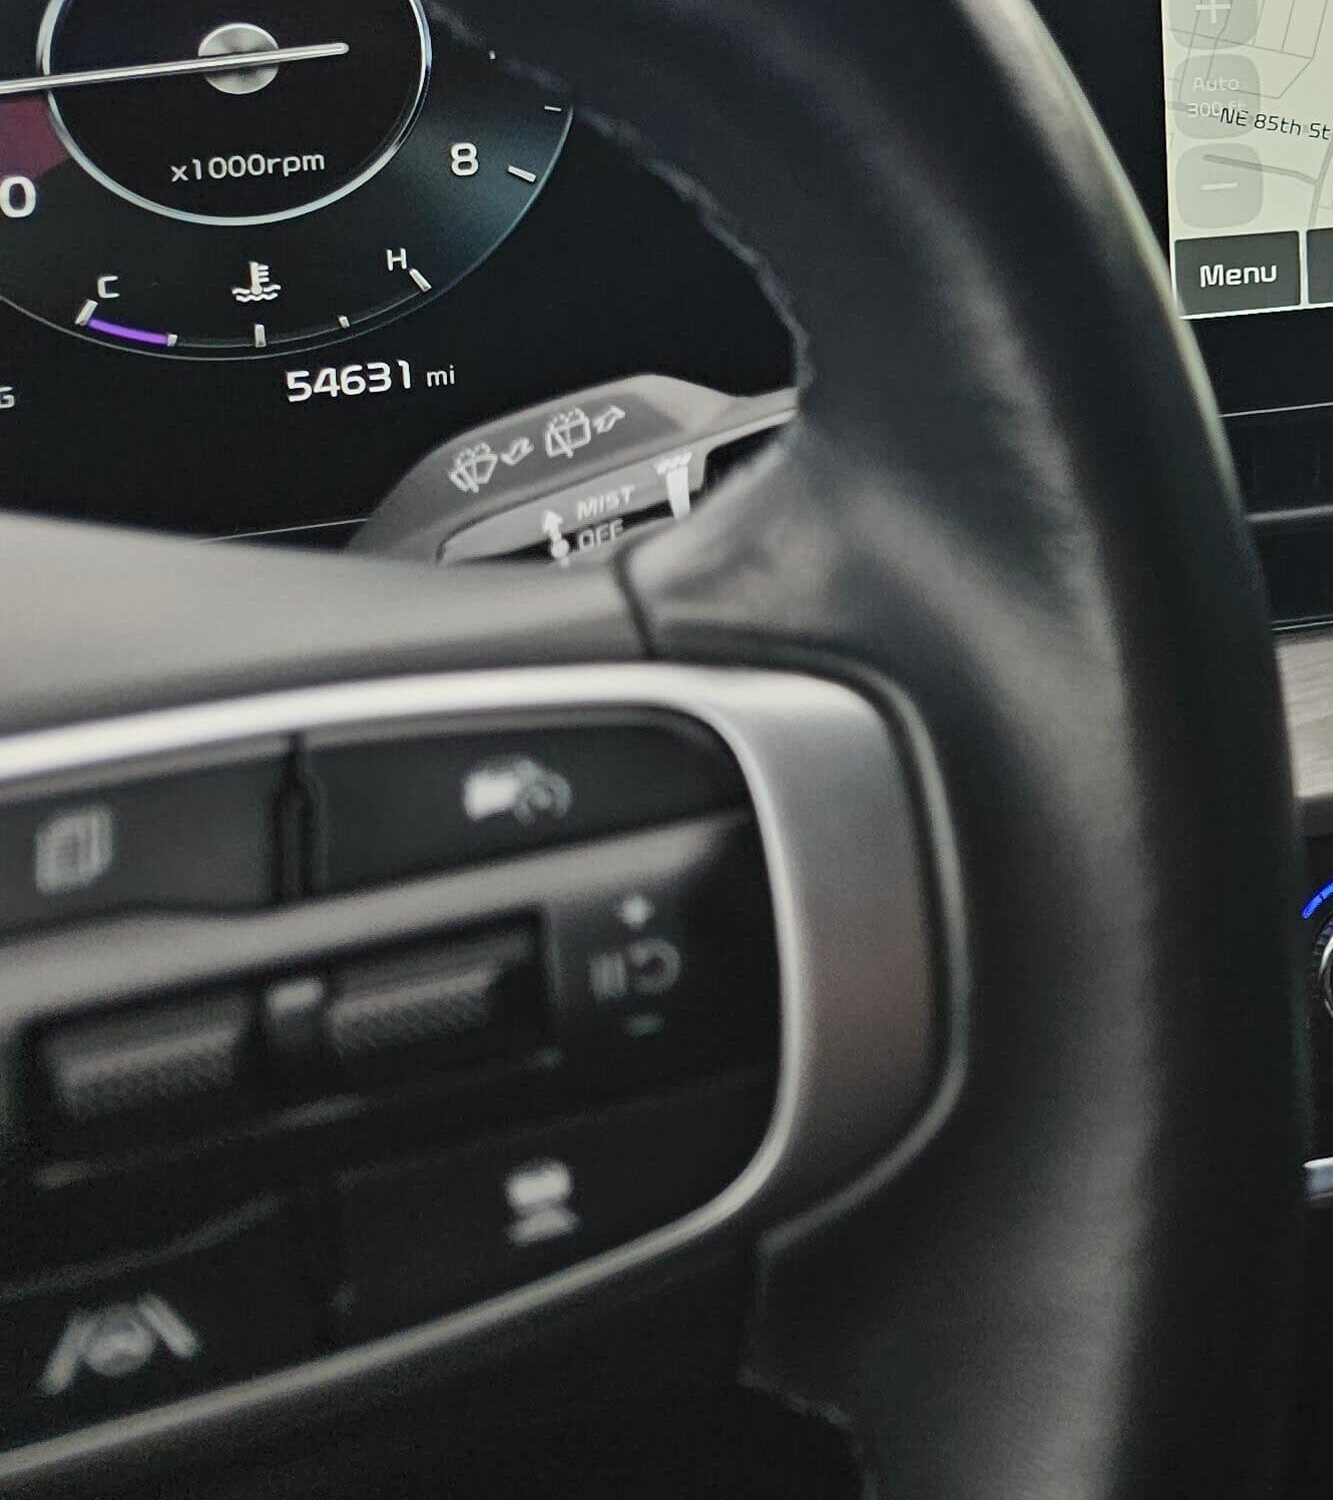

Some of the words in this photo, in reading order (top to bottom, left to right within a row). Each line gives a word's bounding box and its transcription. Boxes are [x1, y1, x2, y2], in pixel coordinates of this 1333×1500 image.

[1192, 77, 1240, 92] Auto
[1220, 108, 1249, 127] NE
[1254, 114, 1302, 136] 85th
[1309, 122, 1331, 140] St
[170, 153, 326, 183] x1000rpm
[450, 142, 480, 177] 8
[0, 175, 37, 218] 0
[386, 248, 408, 272] H
[1199, 263, 1278, 288] Menu
[97, 275, 120, 299] C
[286, 360, 412, 402] 54631
[426, 365, 456, 388] mi
[576, 484, 637, 522] MIST
